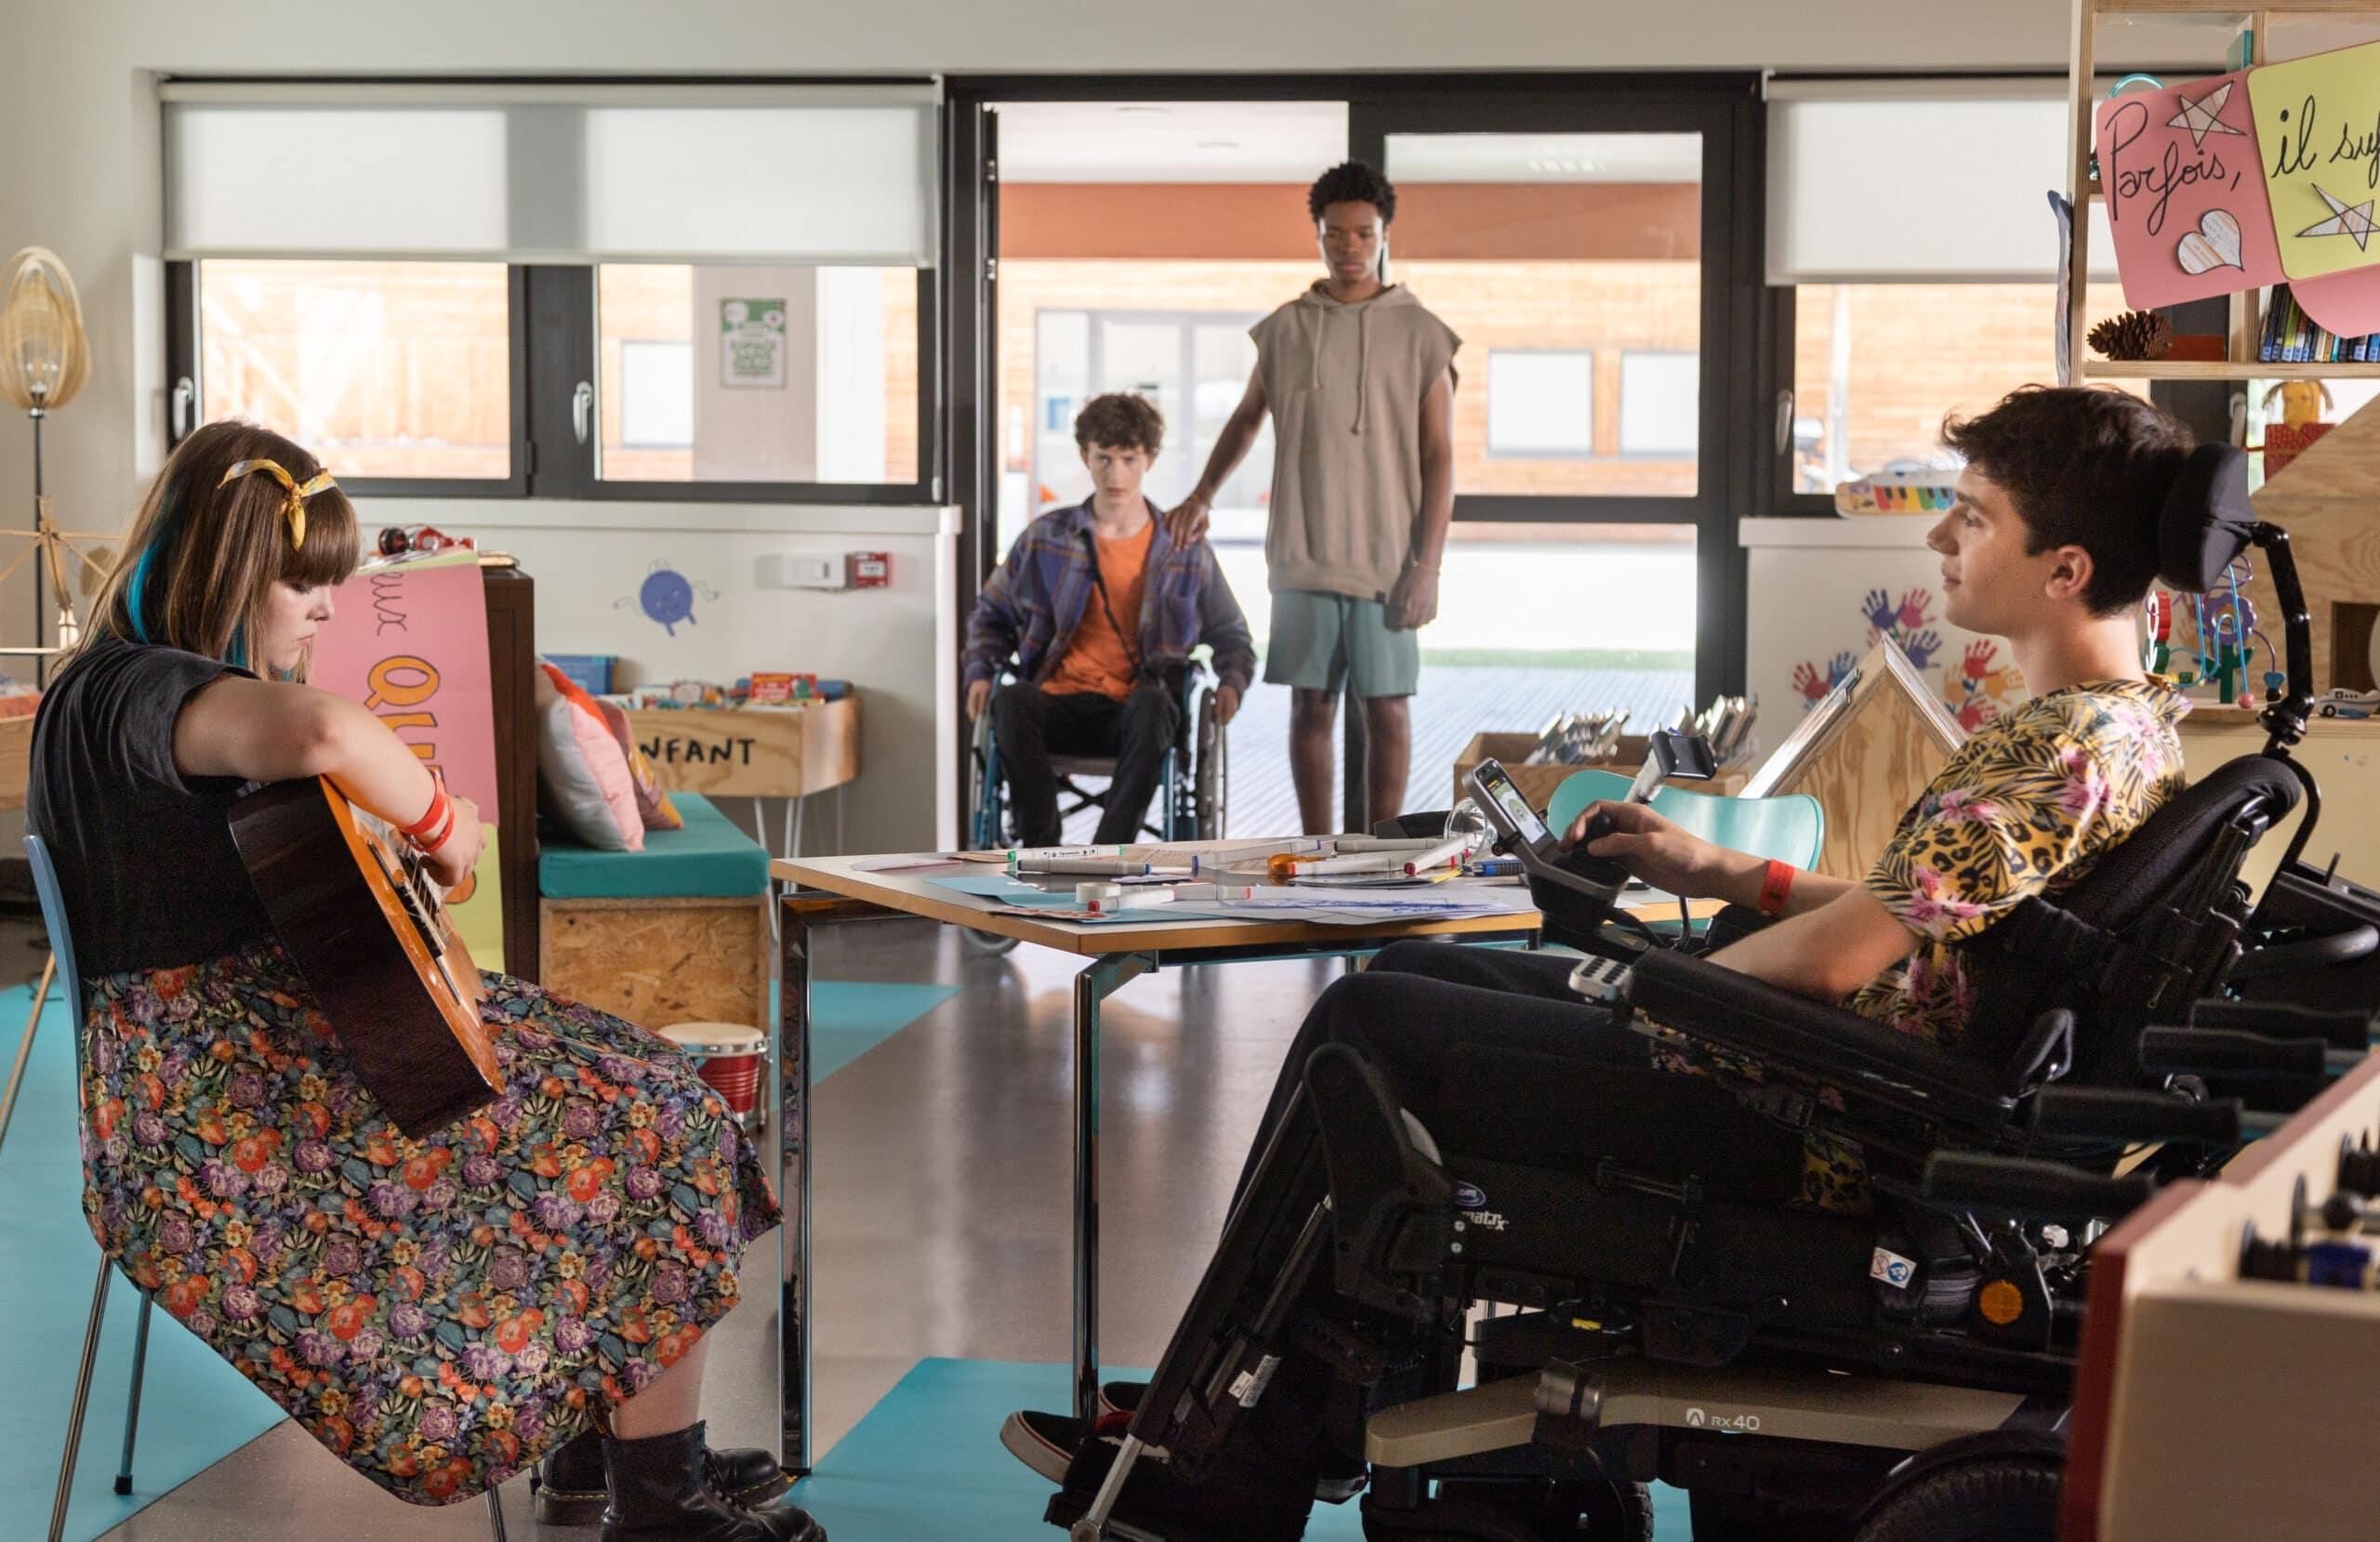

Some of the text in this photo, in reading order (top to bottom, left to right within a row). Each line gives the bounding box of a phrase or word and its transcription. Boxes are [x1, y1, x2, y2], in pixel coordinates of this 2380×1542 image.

[2105, 100, 2241, 236] Parfois,
[2270, 94, 2317, 178] il
[639, 736, 756, 765] NFANT
